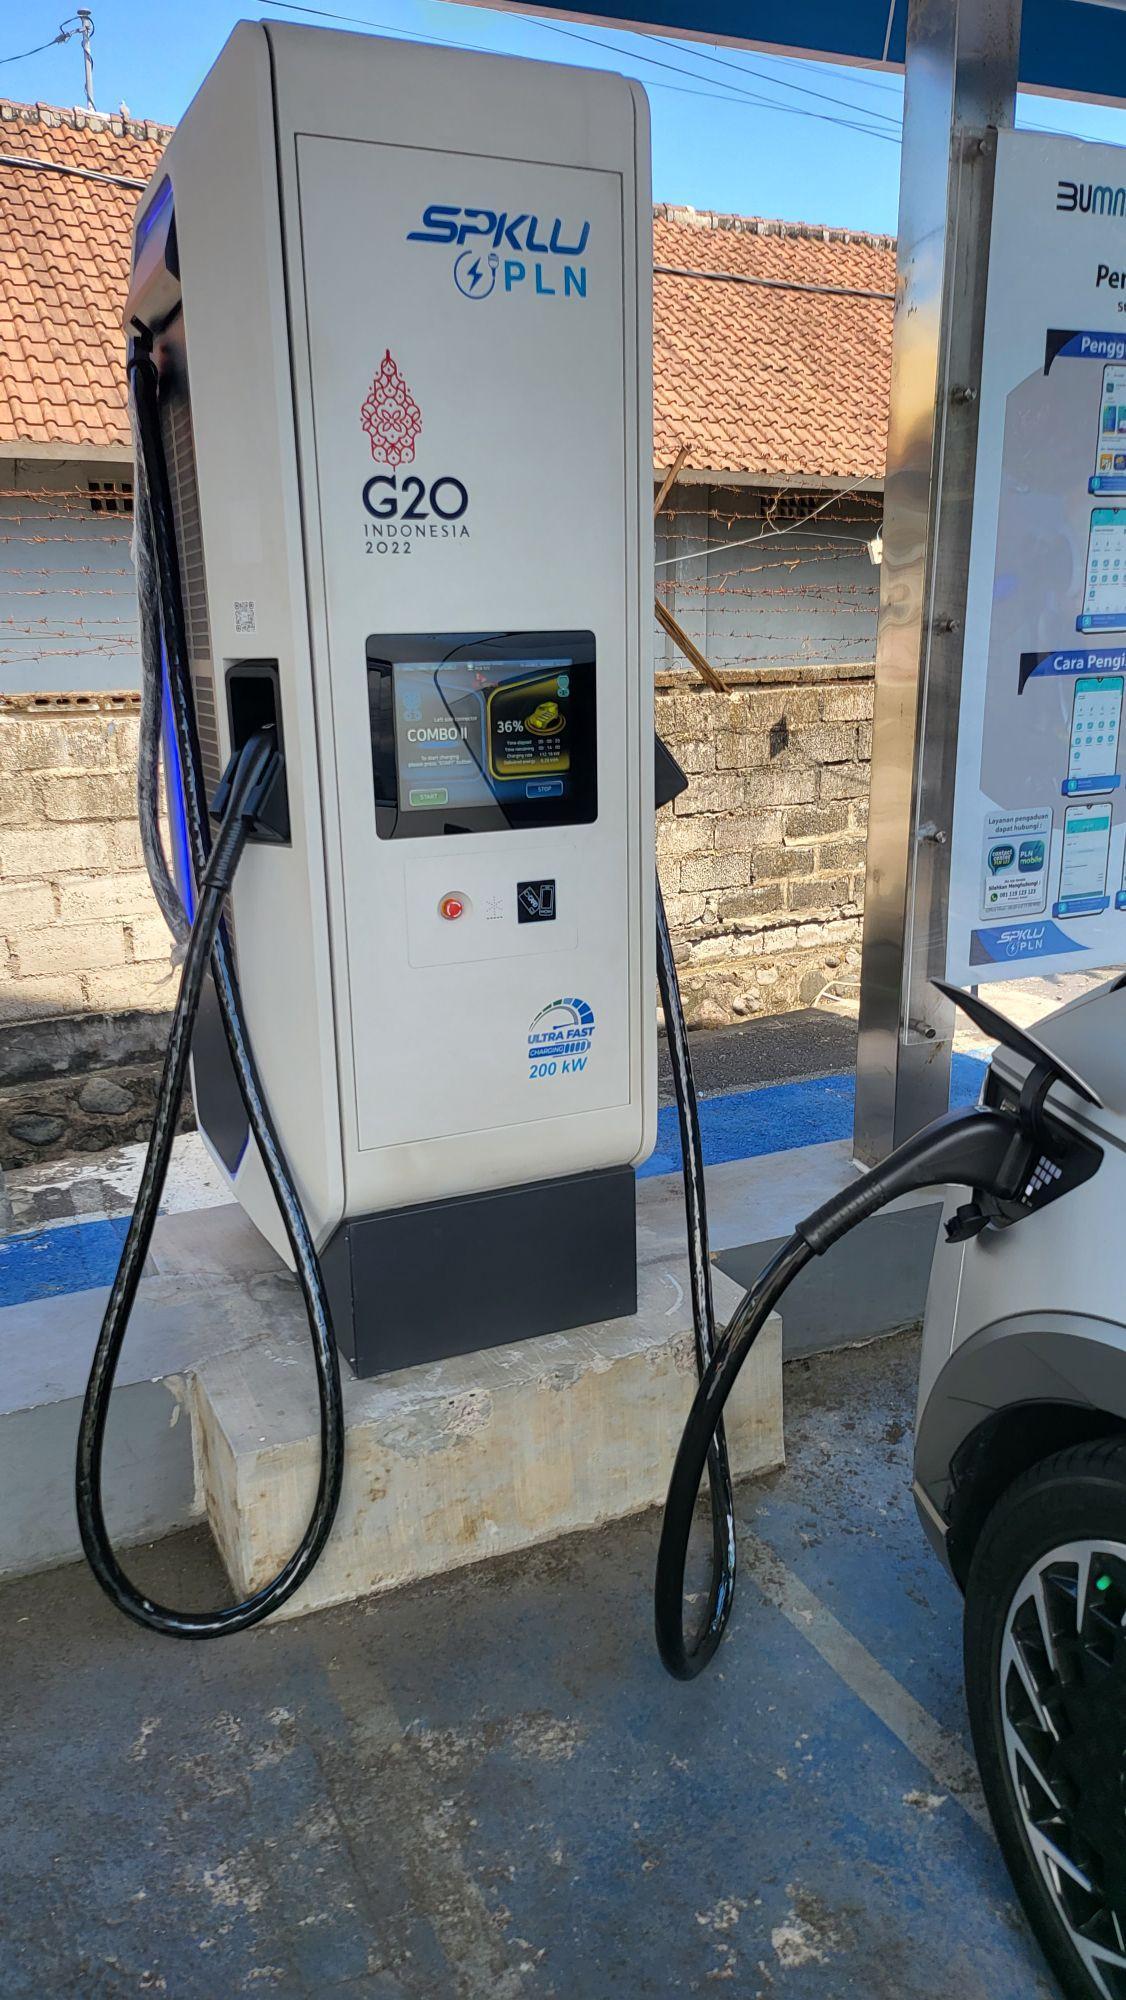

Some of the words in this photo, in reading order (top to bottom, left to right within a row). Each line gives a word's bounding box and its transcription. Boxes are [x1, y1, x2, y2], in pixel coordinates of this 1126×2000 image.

[406, 204, 591, 257] SPKLU
[504, 260, 588, 298] PLN
[1081, 336, 1126, 358] Pengg
[362, 475, 469, 521] G20
[364, 524, 470, 538] INDONESIA
[365, 541, 412, 554] 2022
[1054, 656, 1084, 671] Cara
[497, 720, 524, 733] 36%
[407, 727, 458, 742] COMBO
[537, 785, 553, 793] STOP
[988, 816, 1014, 825] Layanan
[1014, 813, 1049, 823] pengaduan
[995, 825, 1013, 833] dapat
[996, 926, 1045, 944] SPKLU
[1020, 939, 1043, 951] PLN
[527, 1032, 564, 1045] ULTRA
[566, 1026, 596, 1039] FAST
[530, 1045, 564, 1057] CHARGING
[528, 1062, 557, 1079] 200
[562, 1056, 588, 1074] kW
